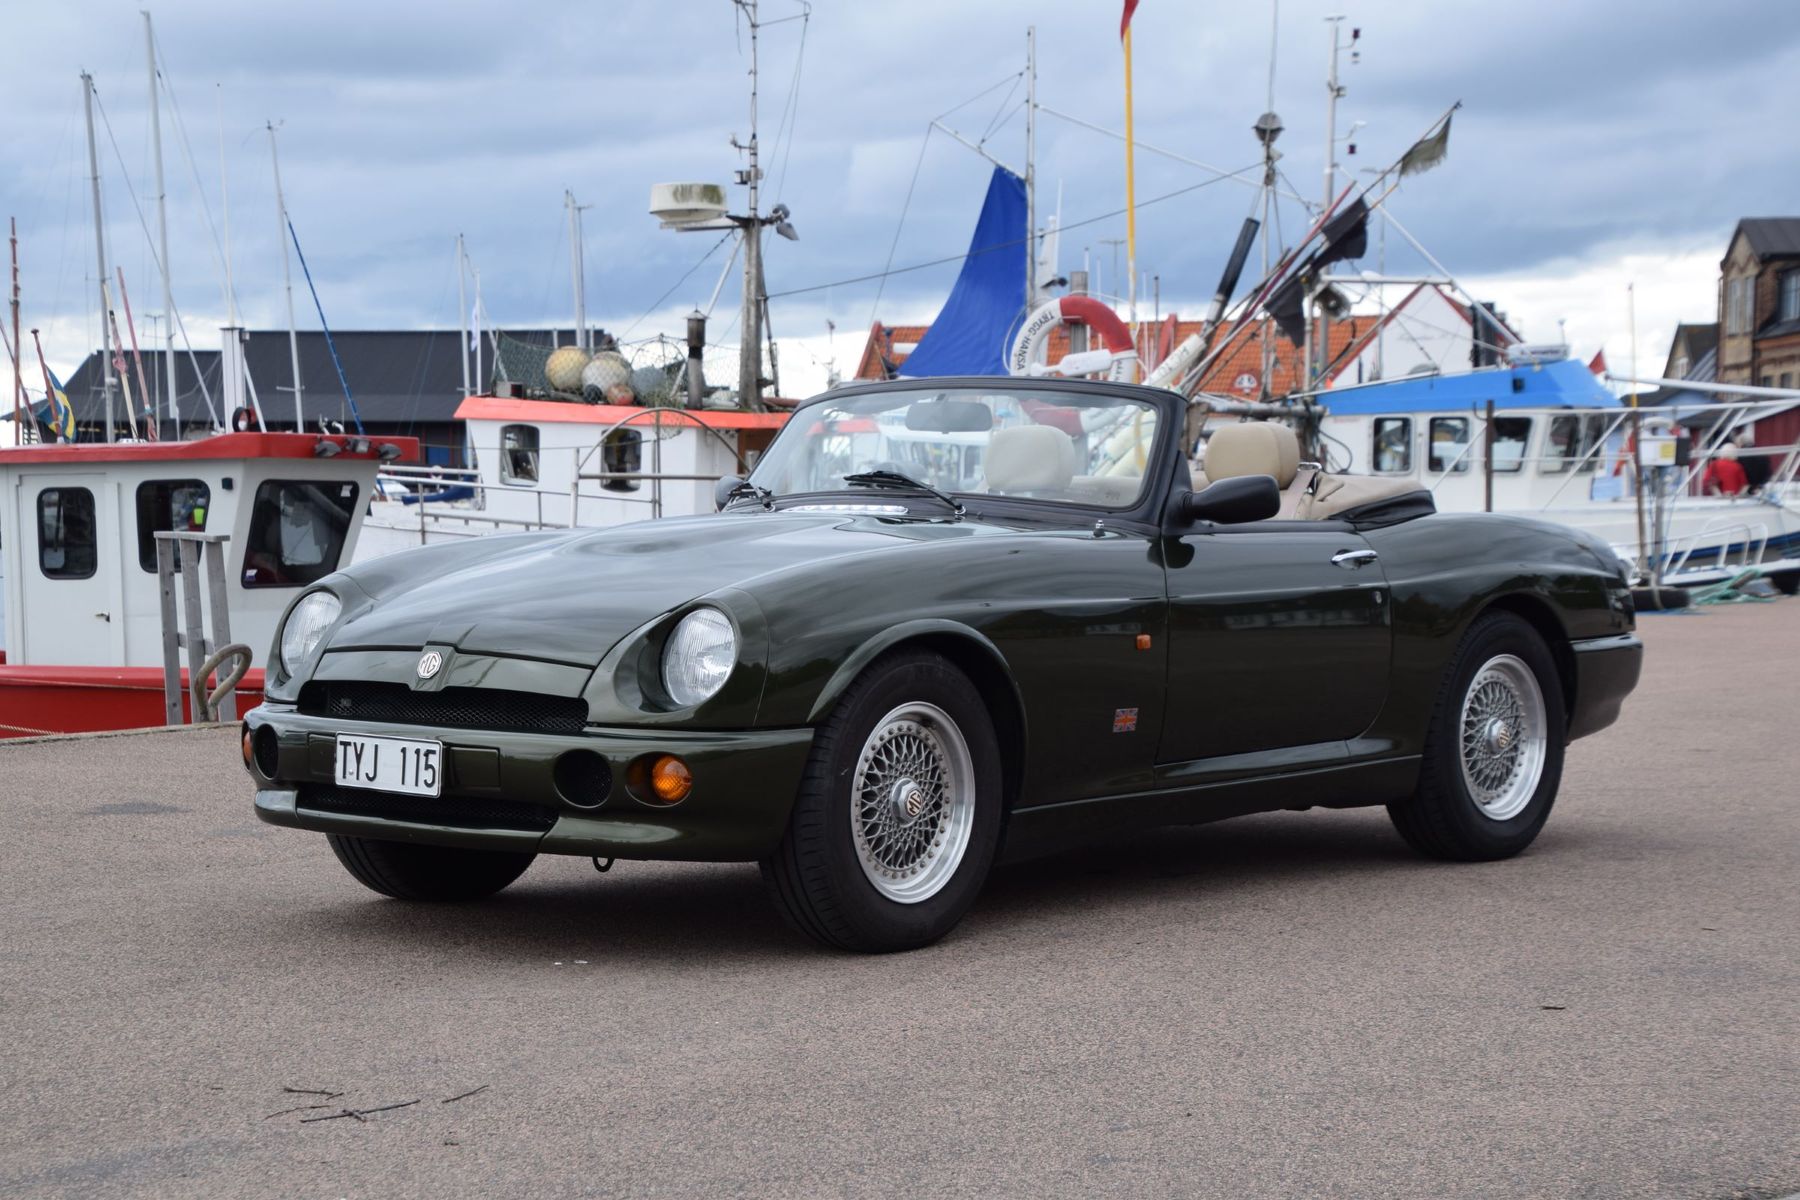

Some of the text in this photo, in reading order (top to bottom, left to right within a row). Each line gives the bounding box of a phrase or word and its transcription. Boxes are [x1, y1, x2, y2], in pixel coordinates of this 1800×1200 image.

[419, 653, 439, 676] MG
[339, 740, 437, 788] TYJ 115
